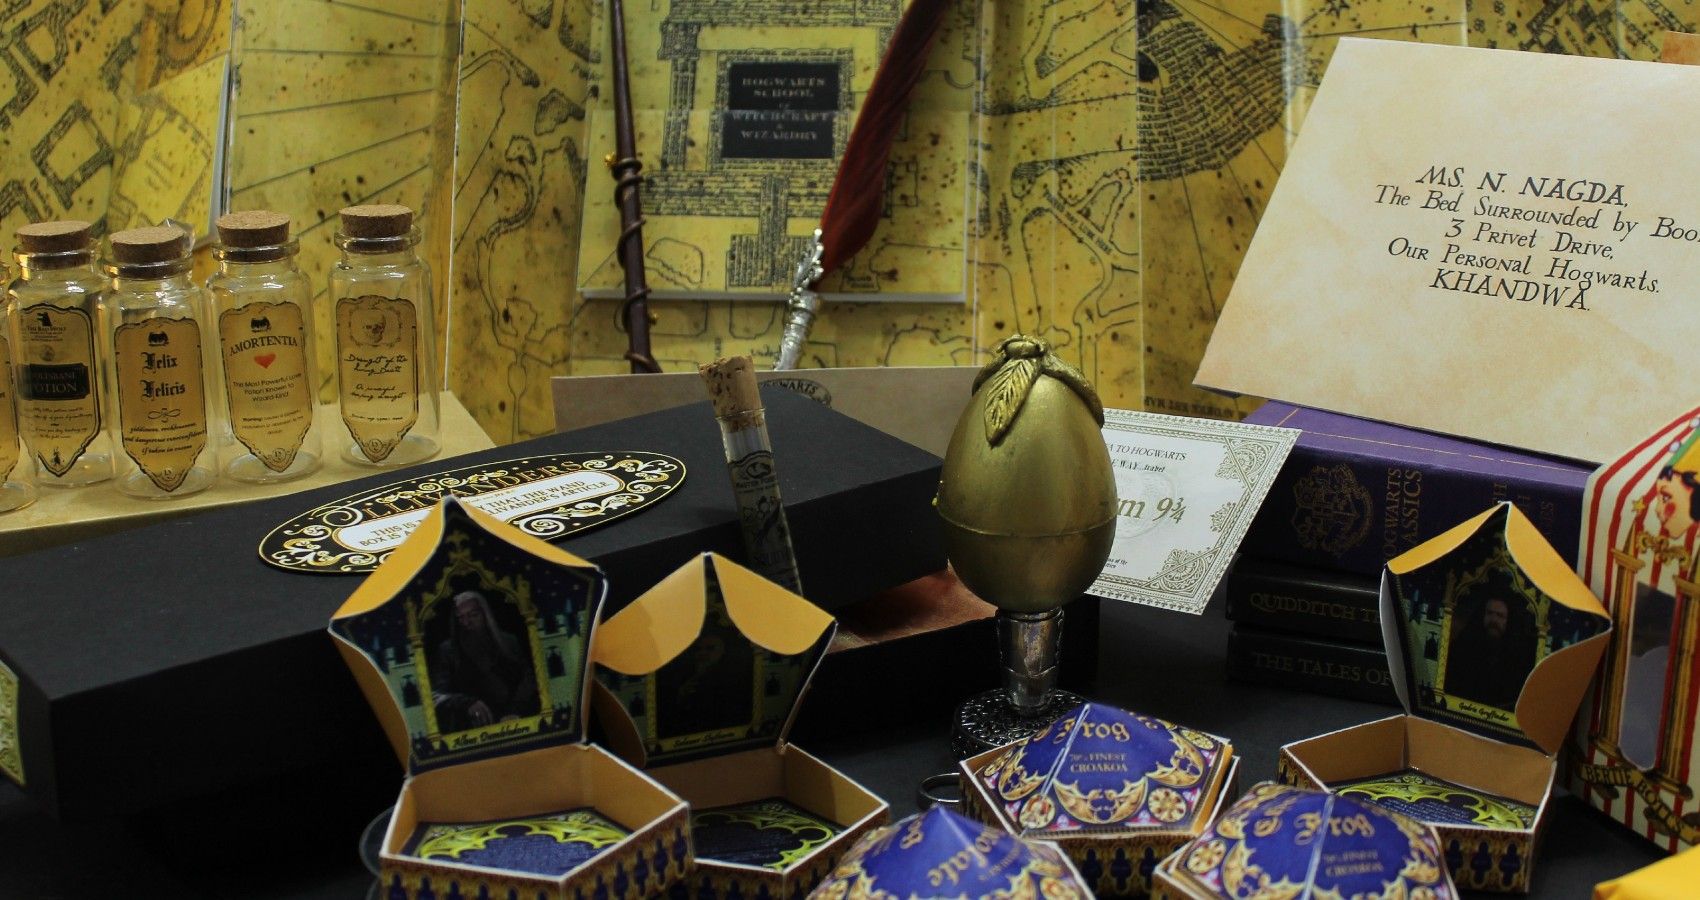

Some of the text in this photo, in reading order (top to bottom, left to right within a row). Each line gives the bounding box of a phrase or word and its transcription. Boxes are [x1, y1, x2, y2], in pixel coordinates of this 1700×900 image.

[742, 77, 825, 87] HOGWARTS
[753, 88, 814, 97] SCHOOL
[731, 111, 828, 121] WITCHCRAFT
[741, 130, 818, 140] WIZARDRY
[1415, 165, 1629, 208] MS. N. NAGDA,
[1375, 184, 1410, 206] The
[1420, 189, 1464, 213] Bed
[1613, 211, 1639, 242] by
[1650, 216, 1700, 243] Boo
[1445, 217, 1614, 260] 3 Privet Drive,
[1388, 237, 1429, 261] Our
[1441, 243, 1531, 275] Personal
[1429, 268, 1590, 311] KHANDWA.
[229, 335, 298, 356] AMORTENTIA
[141, 352, 178, 374] Felix
[140, 379, 186, 402] Felicis
[1117, 444, 1130, 454] TO
[1130, 446, 1186, 461] HOGWARTS
[488, 497, 518, 508] THAT
[523, 490, 549, 500] THE
[548, 480, 585, 495] WAND
[1401, 468, 1423, 544] ASSICS
[1383, 467, 1402, 555] OGWARTS
[360, 536, 388, 547] BOX
[387, 533, 402, 542] IS
[371, 525, 402, 537] THIS
[402, 520, 417, 529] IS
[1249, 592, 1355, 620] QUIDDITCH
[1252, 651, 1294, 673] THE
[1297, 657, 1361, 682] TALES
[1053, 717, 1131, 744] Frog
[1584, 765, 1632, 786] BERTIE
[1293, 811, 1376, 846] Frog
